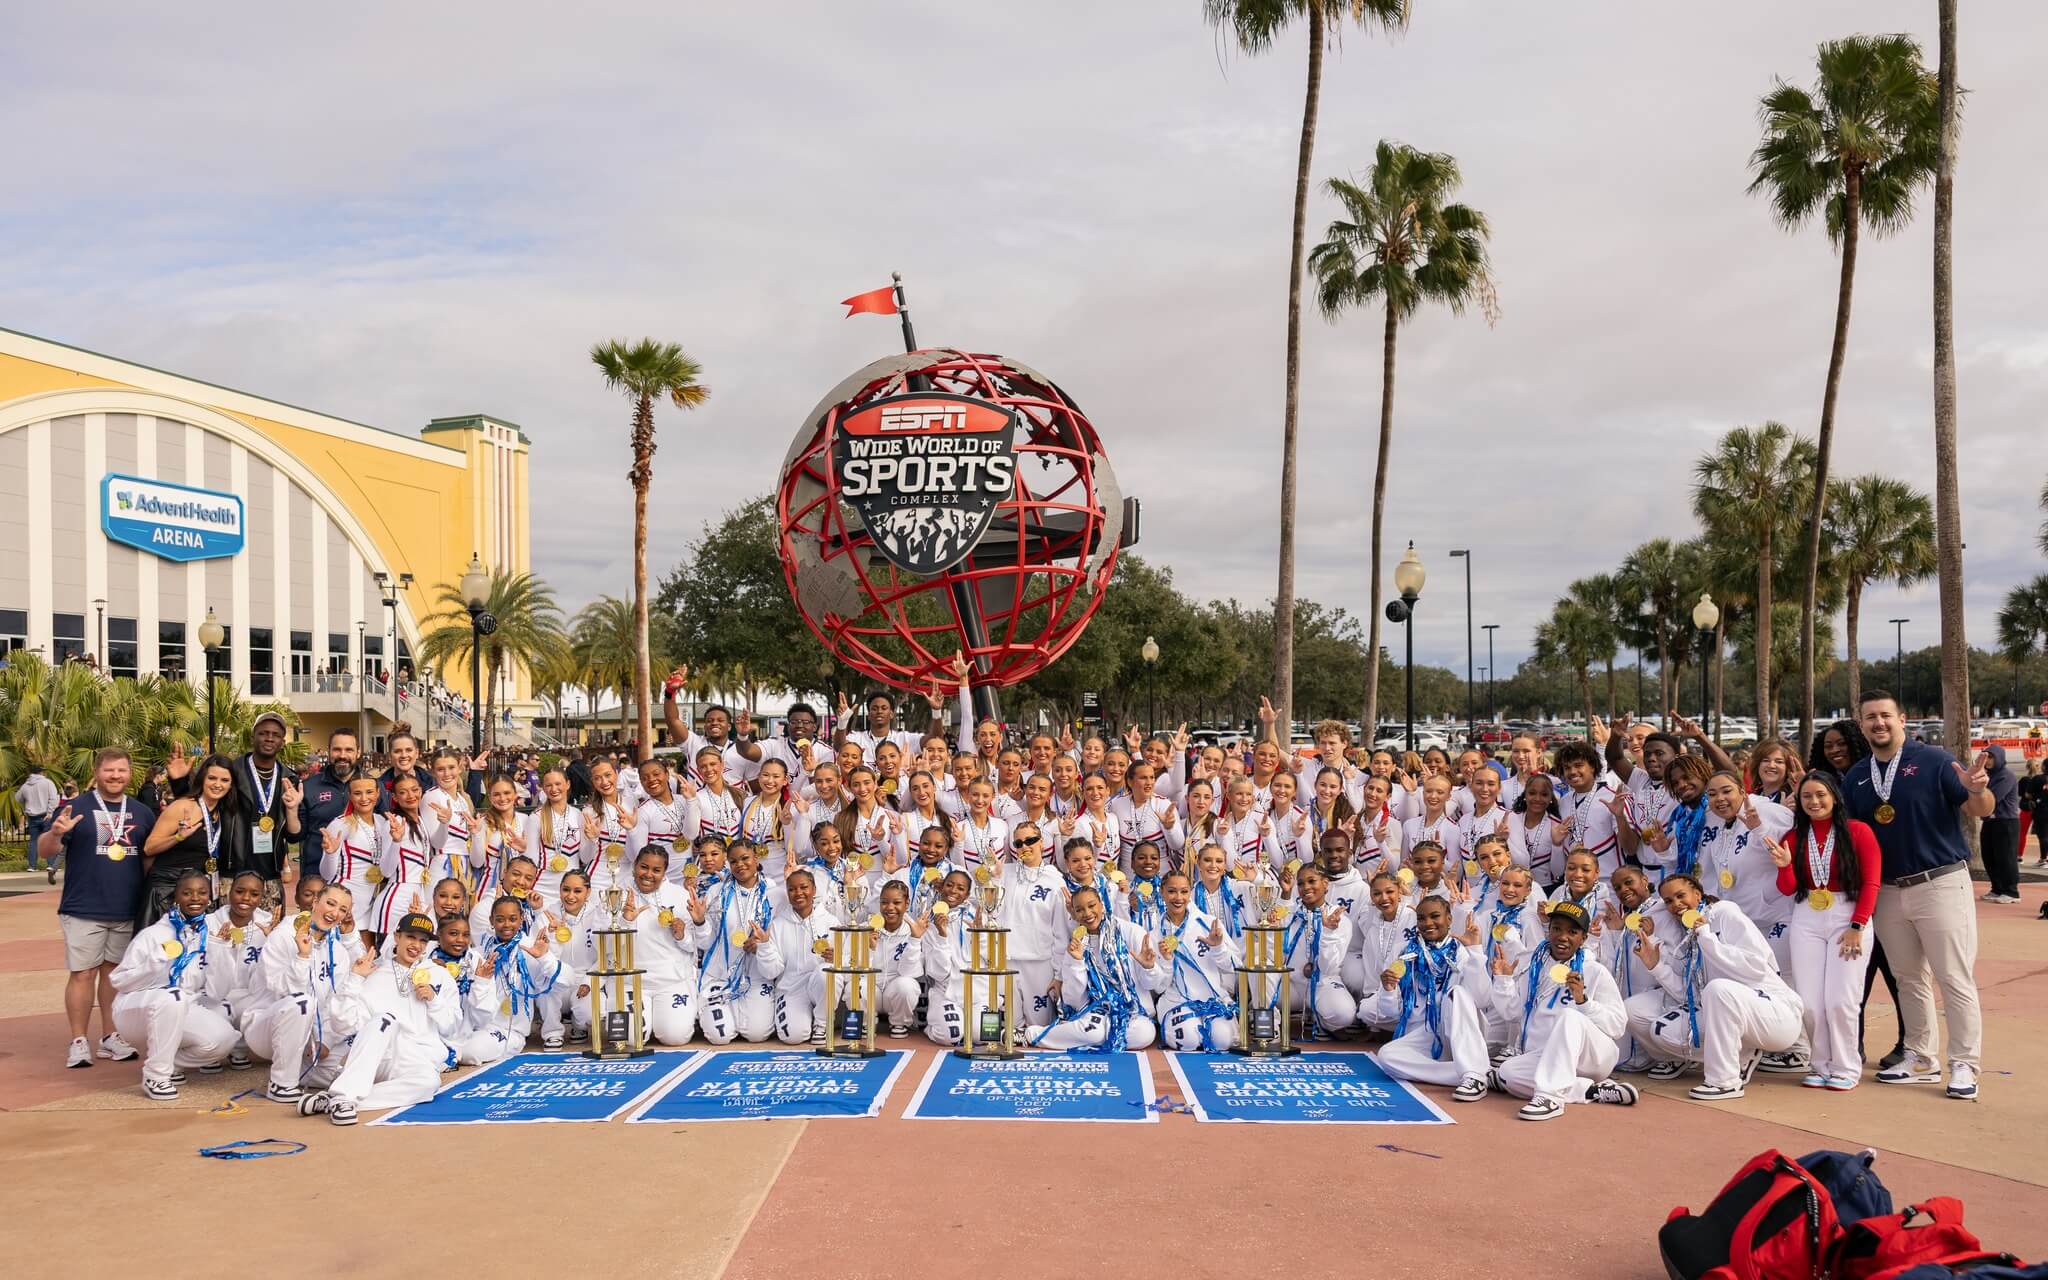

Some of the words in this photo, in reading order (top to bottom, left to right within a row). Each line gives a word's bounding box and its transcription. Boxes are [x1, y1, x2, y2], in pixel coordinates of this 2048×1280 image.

[880, 405, 967, 431] ESPN
[849, 439, 902, 458] WIDE
[905, 436, 978, 455] WORLD
[981, 440, 1002, 454] OF
[842, 456, 1013, 496] SPORTS
[890, 494, 959, 505] COMPLEX
[135, 494, 236, 525] AdventHealth
[152, 527, 204, 549] ARENA
[469, 1081, 627, 1092] NATIONAL
[697, 1079, 860, 1090] NATIONAL
[955, 1078, 1118, 1089] NATIONAL
[1213, 1081, 1381, 1090] NATIONAL
[451, 1089, 626, 1099] CHAMPIONS
[685, 1086, 860, 1097] CHAMPIONS
[949, 1087, 1122, 1096] CHAMPIONS
[1214, 1089, 1391, 1098] CHAMPIONS
[1226, 1098, 1284, 1107] OPEN
[1296, 1099, 1339, 1107] ALL
[1347, 1099, 1397, 1107] GIRL
